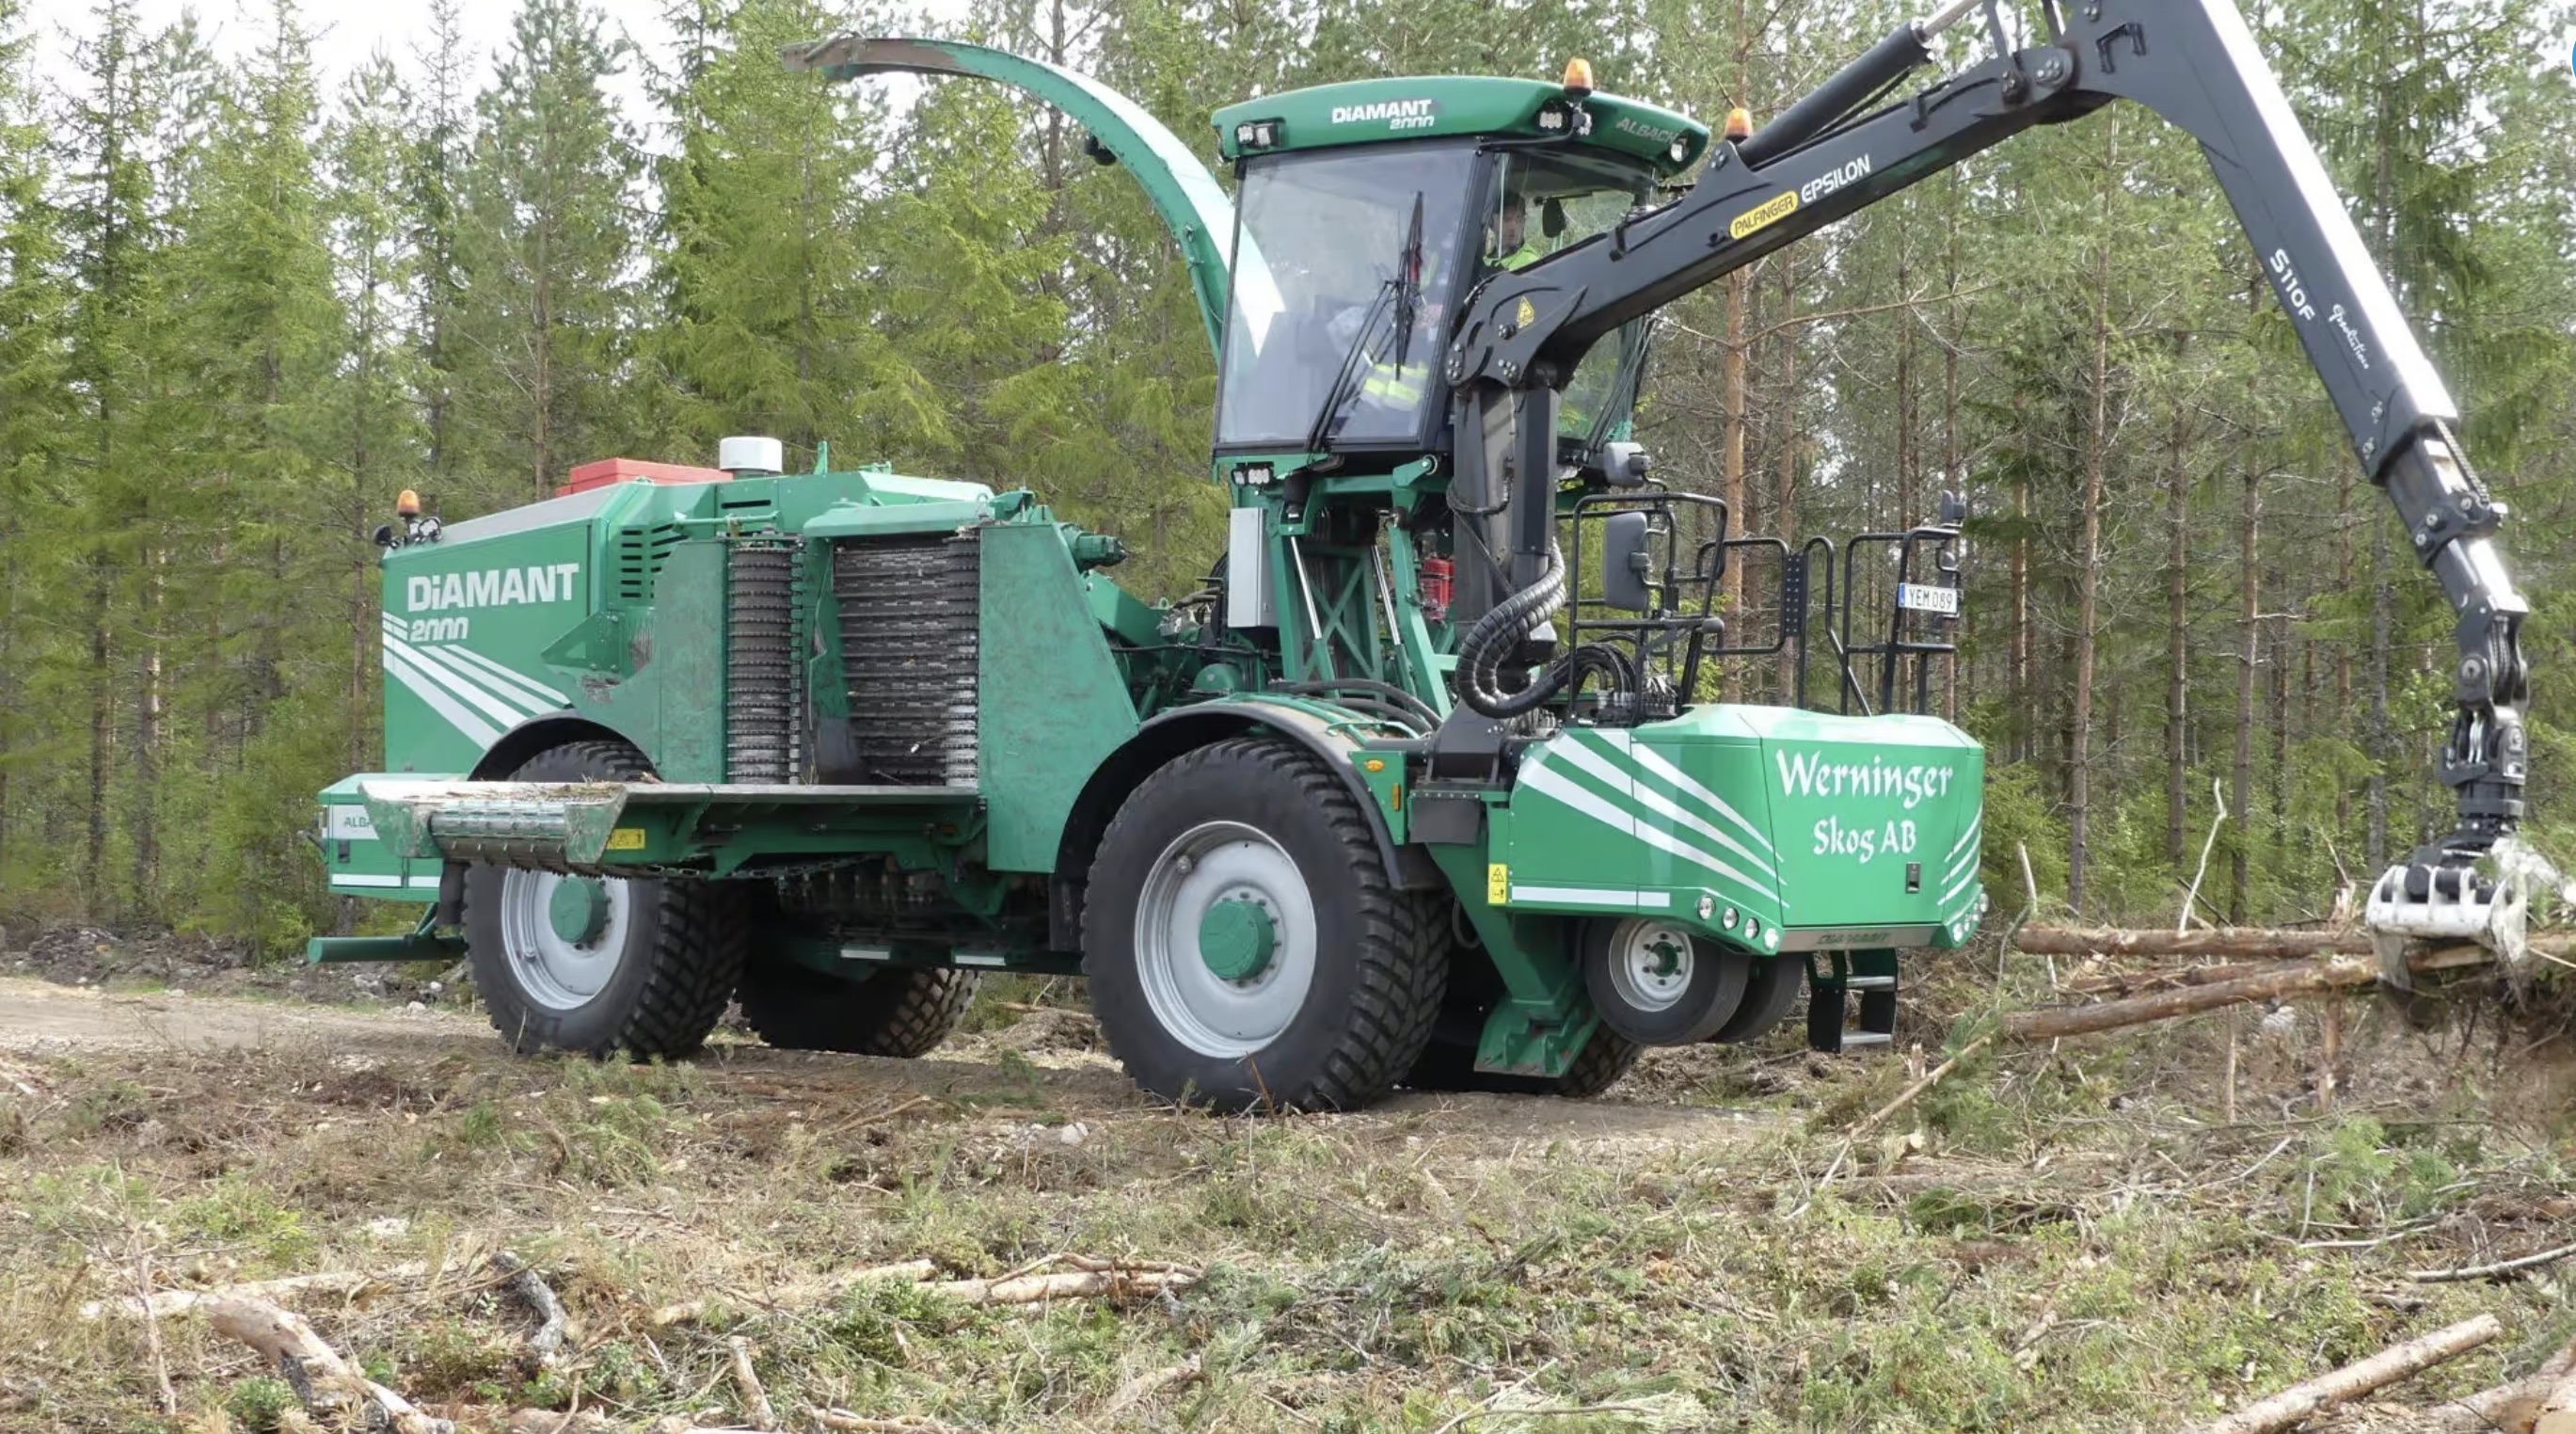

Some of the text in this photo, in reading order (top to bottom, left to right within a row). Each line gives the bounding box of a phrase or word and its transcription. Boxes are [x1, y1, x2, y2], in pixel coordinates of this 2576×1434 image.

[1331, 99, 1432, 123] DiAMANT
[1390, 115, 1435, 130] 2000
[1615, 117, 1678, 144] ALBACH
[1735, 153, 1871, 234] PALFINGER EPSILON
[2269, 248, 2315, 320] S110F
[407, 563, 580, 613] DiAMANT
[1909, 588, 1952, 610] YEM 089
[410, 617, 469, 643] 2000
[1775, 749, 1953, 809] Werninger
[1813, 815, 1916, 864] Skog AB
